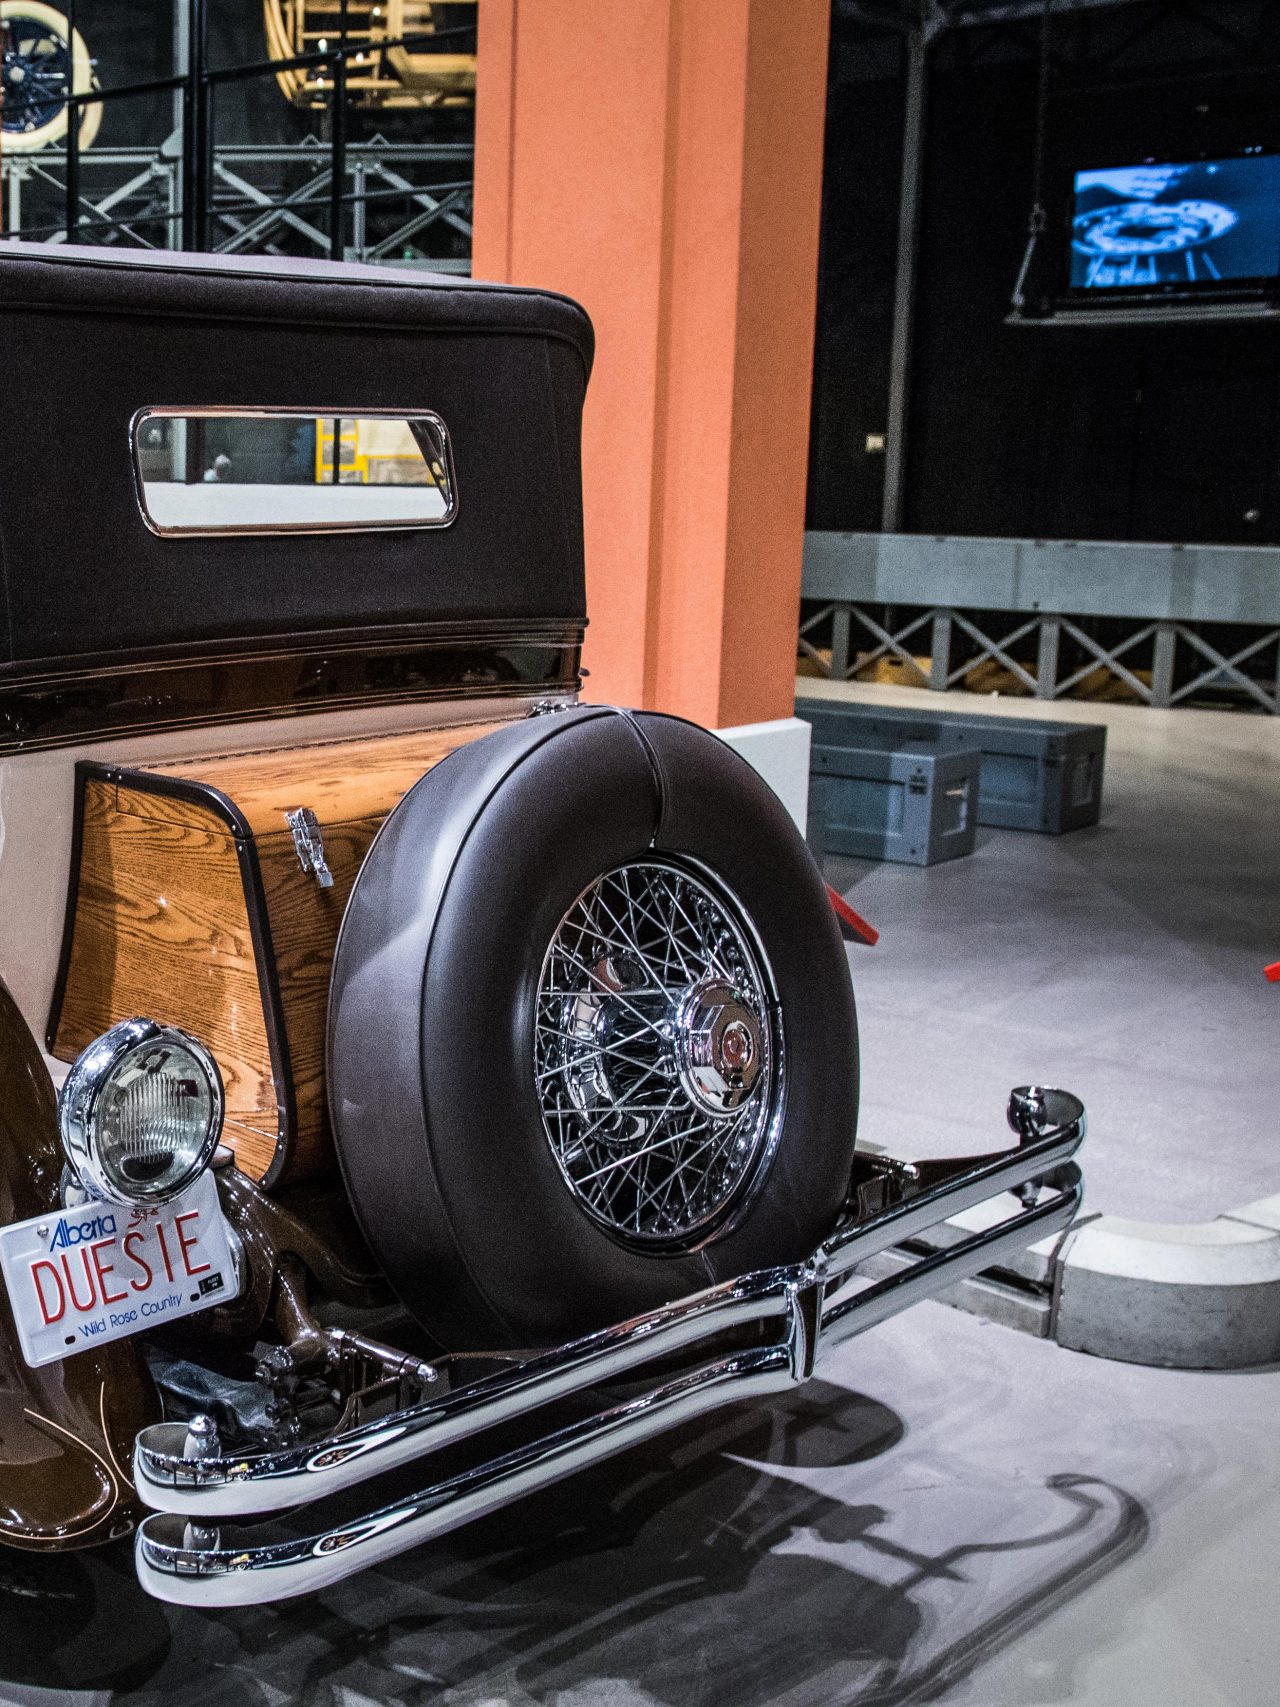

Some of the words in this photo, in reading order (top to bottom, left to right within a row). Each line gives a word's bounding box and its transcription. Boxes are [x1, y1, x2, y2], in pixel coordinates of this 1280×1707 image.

[50, 1214, 117, 1252] Alberta
[30, 1211, 211, 1326] DUESIE
[78, 1318, 107, 1338] Wild
[109, 1309, 138, 1328] Rose
[140, 1293, 183, 1317] Country
